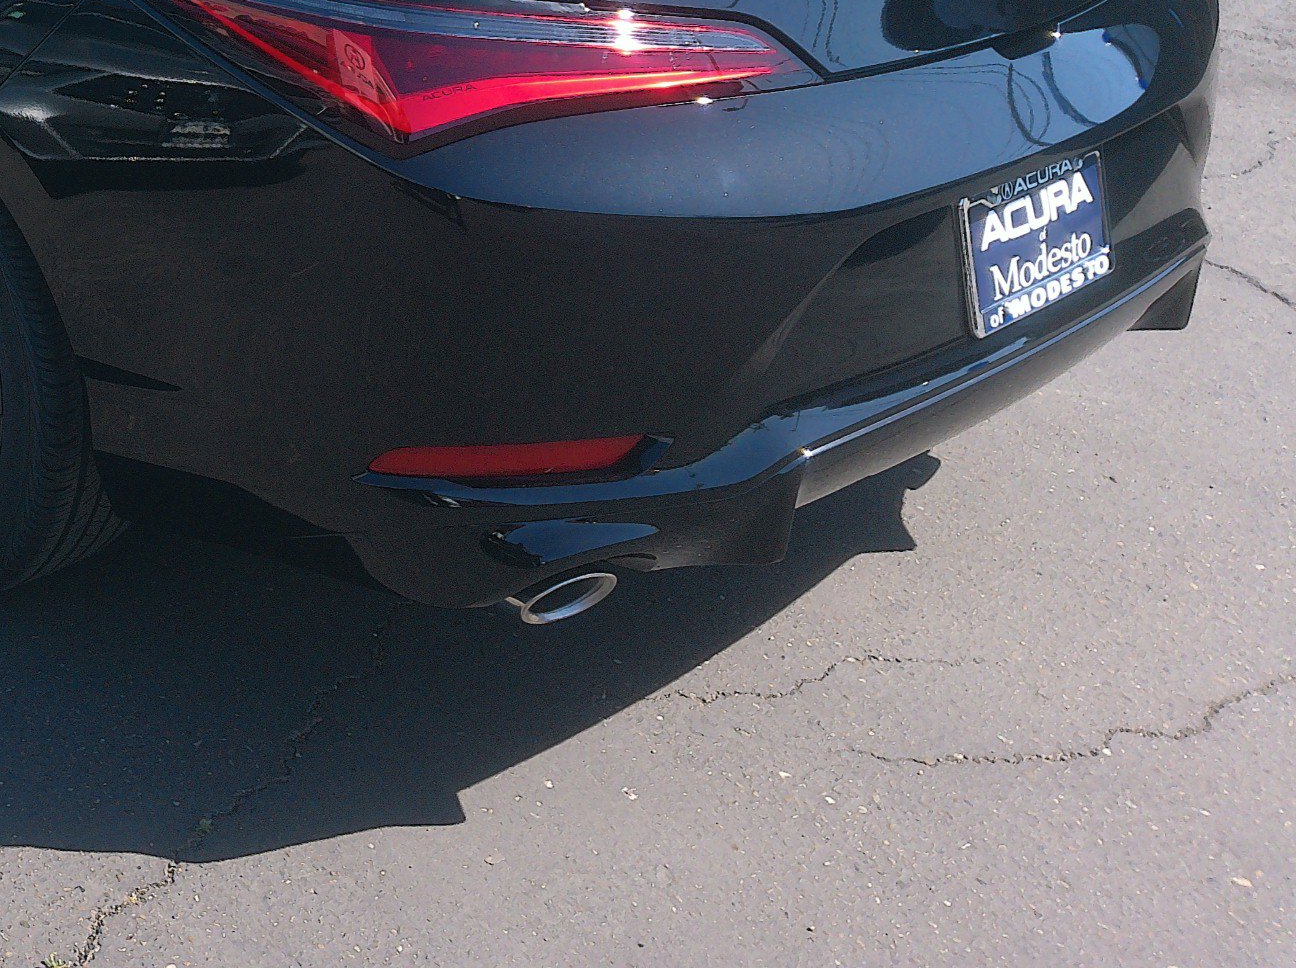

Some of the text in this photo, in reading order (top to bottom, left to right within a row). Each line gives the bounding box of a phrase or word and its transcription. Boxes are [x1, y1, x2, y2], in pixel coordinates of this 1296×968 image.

[980, 171, 1094, 252] ACURA
[1013, 159, 1073, 196] ACURA
[989, 231, 1092, 301] Modesto
[990, 255, 1110, 328] of MODESTO
